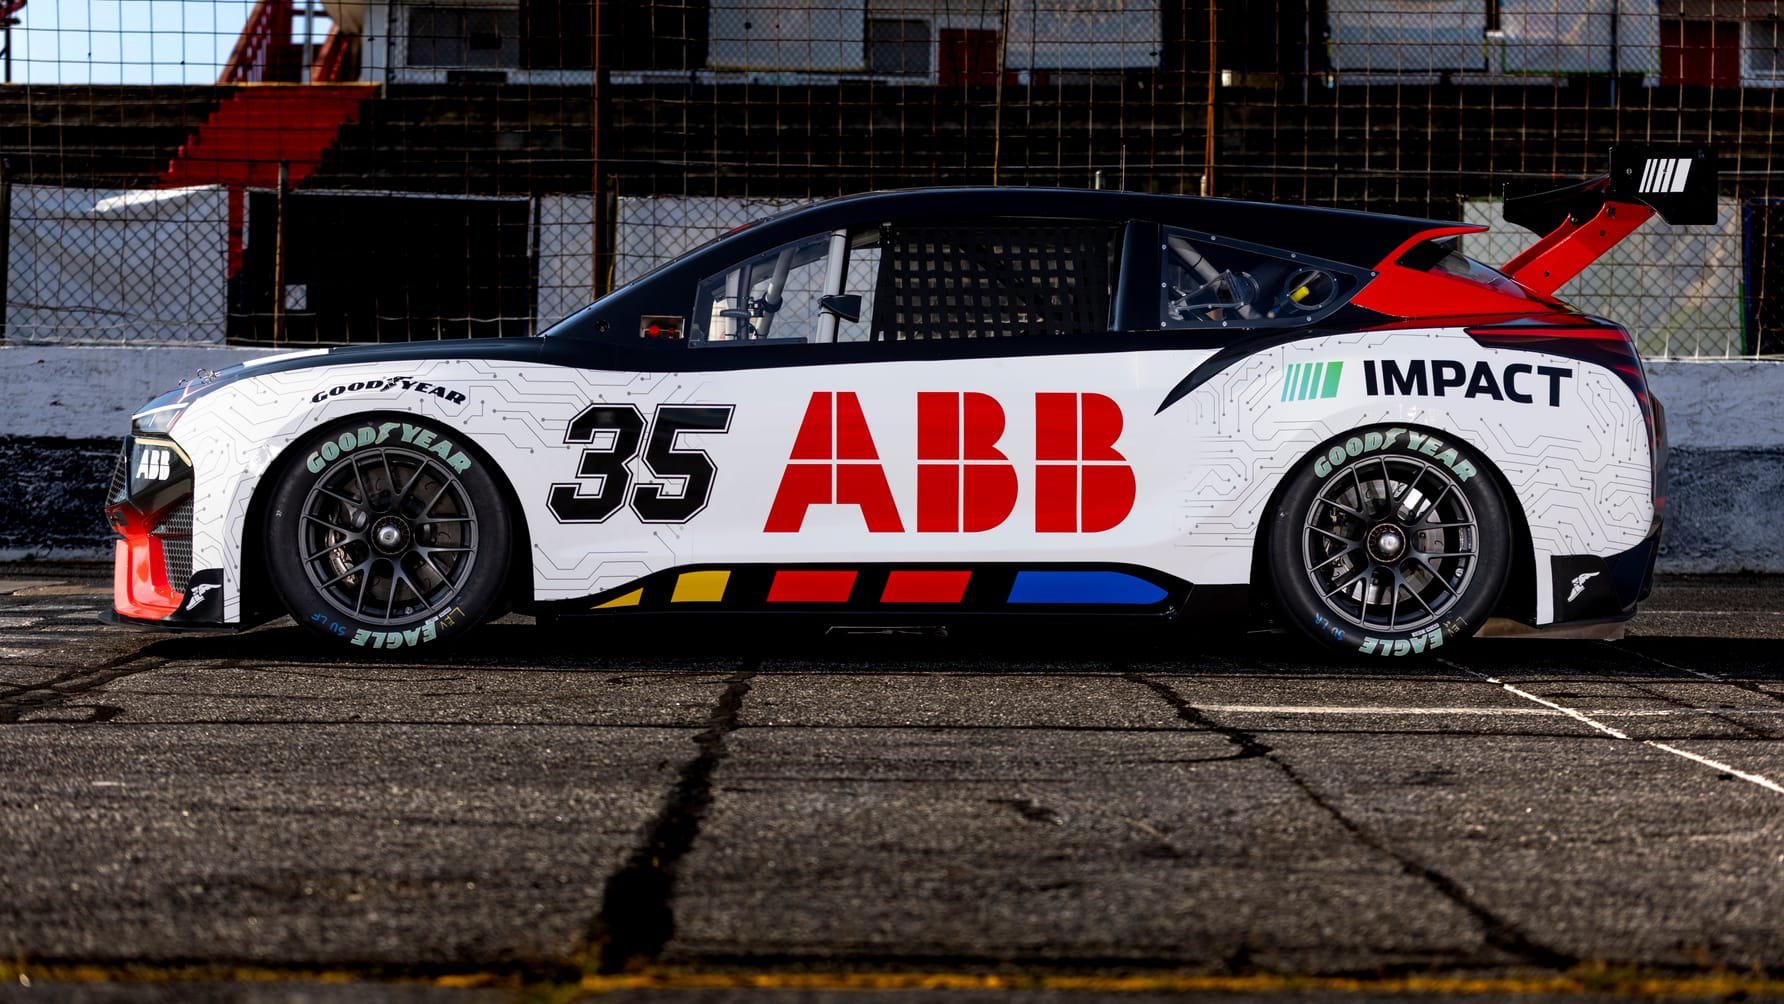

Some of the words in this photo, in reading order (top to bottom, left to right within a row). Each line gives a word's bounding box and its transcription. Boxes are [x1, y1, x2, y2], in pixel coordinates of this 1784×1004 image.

[1363, 359, 1573, 408] IMPACT
[135, 449, 171, 481] ABB
[546, 402, 737, 525] 35
[762, 391, 1137, 533] ABB
[350, 623, 437, 649] EAGLE
[1358, 628, 1444, 656] EAGLE
